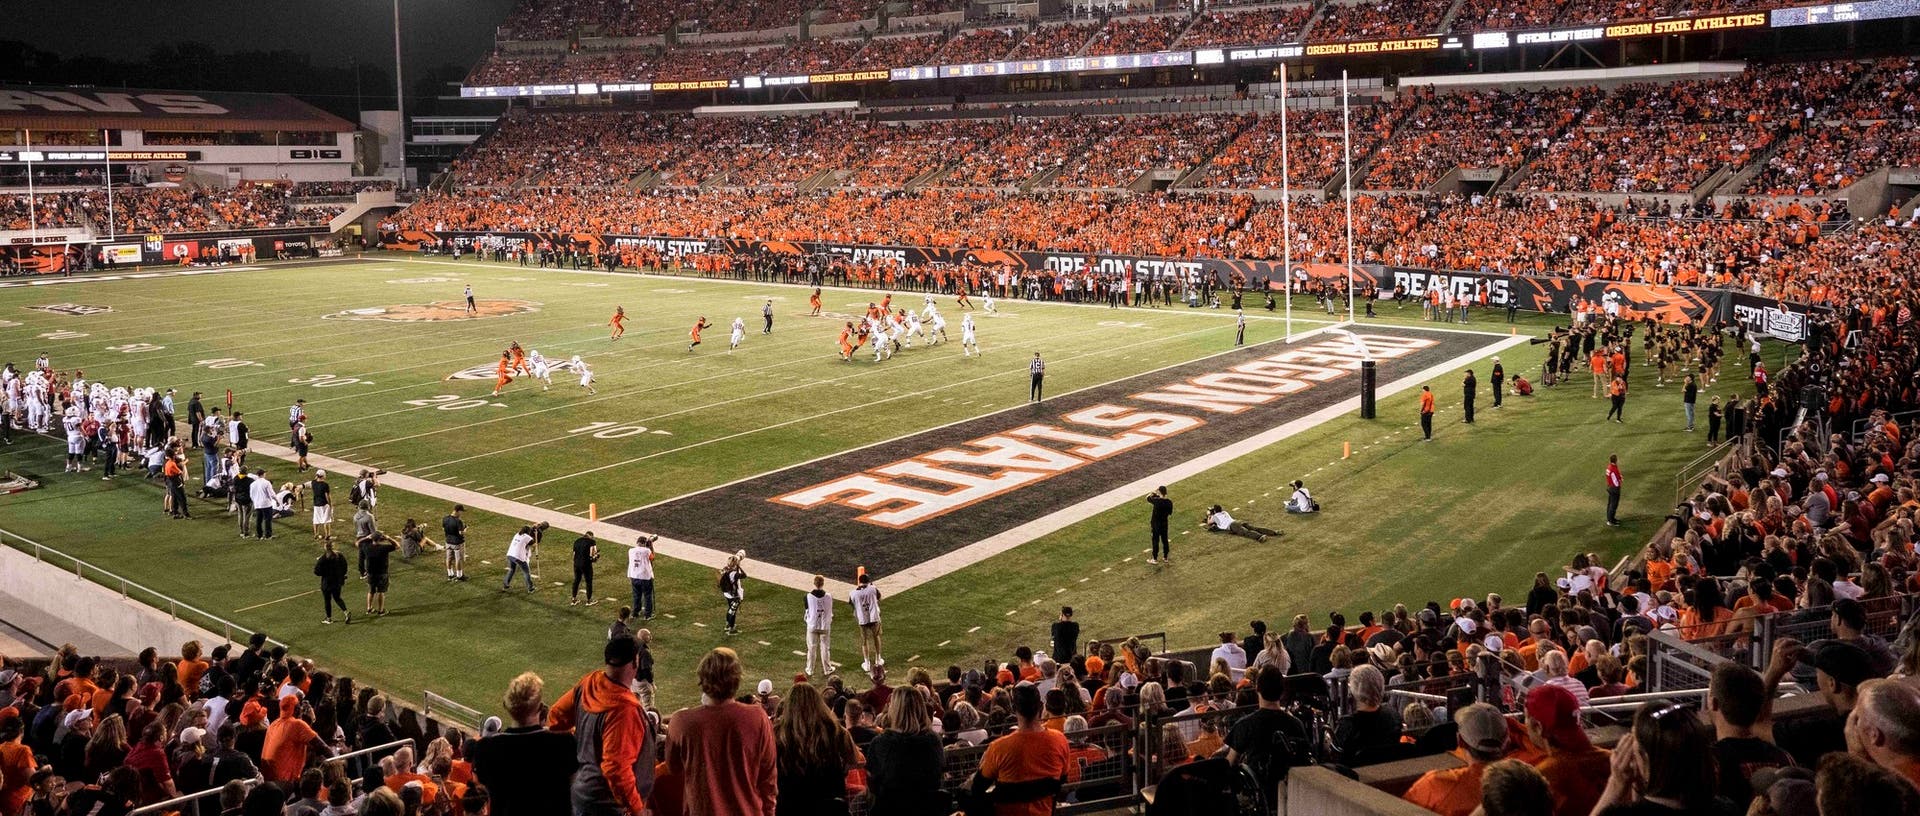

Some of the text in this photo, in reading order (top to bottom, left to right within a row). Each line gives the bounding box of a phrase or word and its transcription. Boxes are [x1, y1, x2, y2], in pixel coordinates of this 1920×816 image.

[1606, 23, 1652, 37] OREGON
[1654, 20, 1691, 33] STATE
[1693, 13, 1765, 30] ATHLETICS
[1307, 42, 1346, 55] OREGON
[1348, 41, 1378, 53] STATE
[1380, 39, 1439, 51] ATHLETICS
[680, 82, 698, 90] STATE
[700, 80, 728, 89] ATHLETICS
[810, 74, 833, 83] OREGON
[835, 73, 852, 82] STATE
[854, 71, 888, 80] ATHLETICS
[107, 152, 132, 160] OREGON
[133, 152, 152, 160] STATE
[44, 235, 67, 243] STATE
[147, 241, 162, 251] 40
[667, 240, 708, 257] STATE
[1044, 256, 1203, 283] OREON STATE
[288, 374, 361, 388] 30
[402, 394, 489, 411] 20
[567, 421, 648, 439] 10
[771, 332, 1440, 530] OREGON STATE
